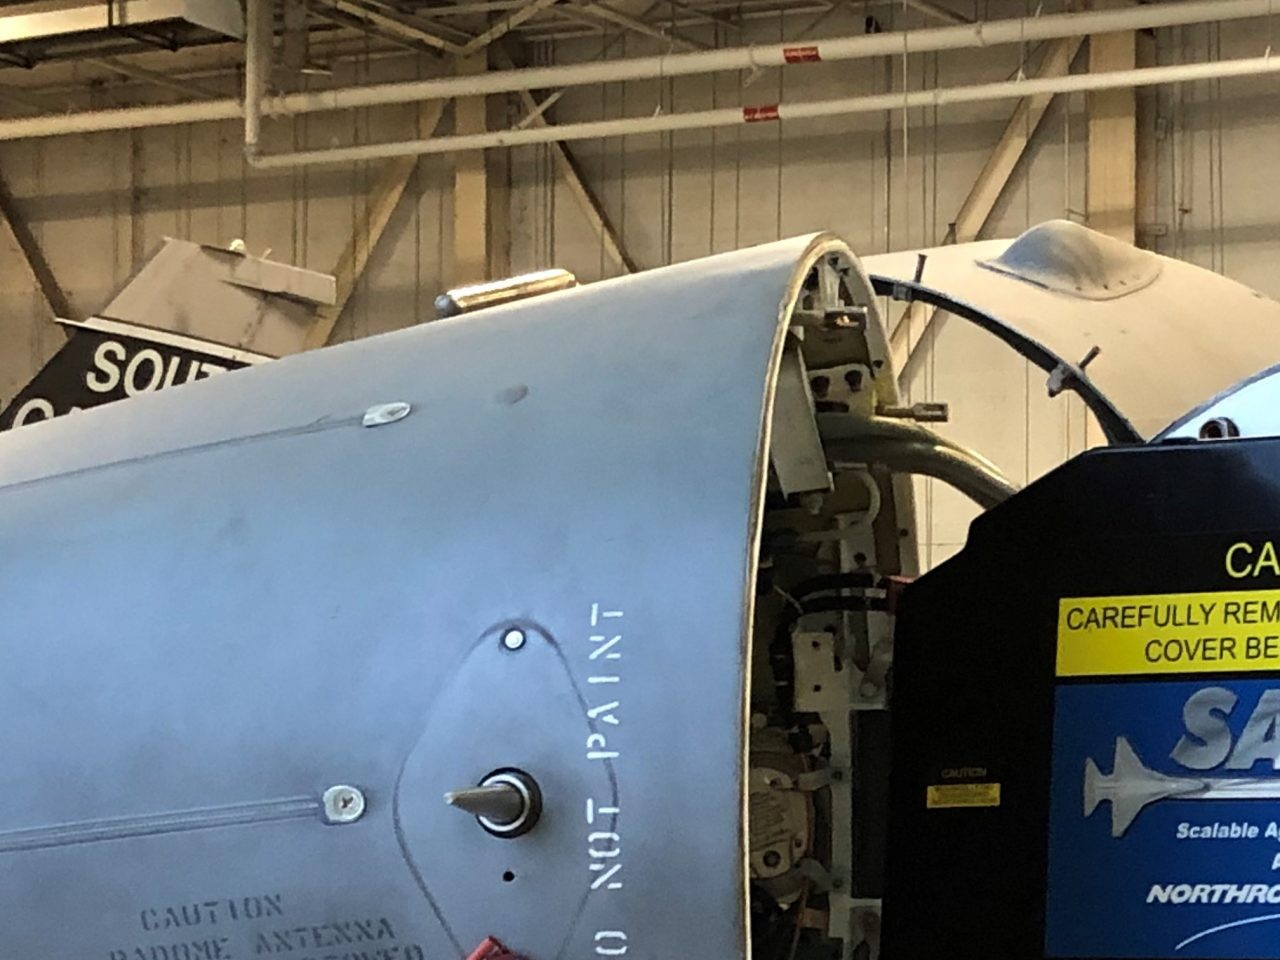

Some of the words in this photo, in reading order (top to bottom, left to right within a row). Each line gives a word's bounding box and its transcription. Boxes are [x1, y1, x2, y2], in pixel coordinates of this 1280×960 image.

[1066, 602, 1217, 631] CAREFULLY
[1145, 637, 1237, 663] COVER
[586, 602, 624, 759] PAINT
[586, 798, 623, 889] NOT
[1176, 822, 1259, 840] Scalable
[141, 894, 283, 931] CAUTION
[256, 917, 396, 954] ANTENNA
